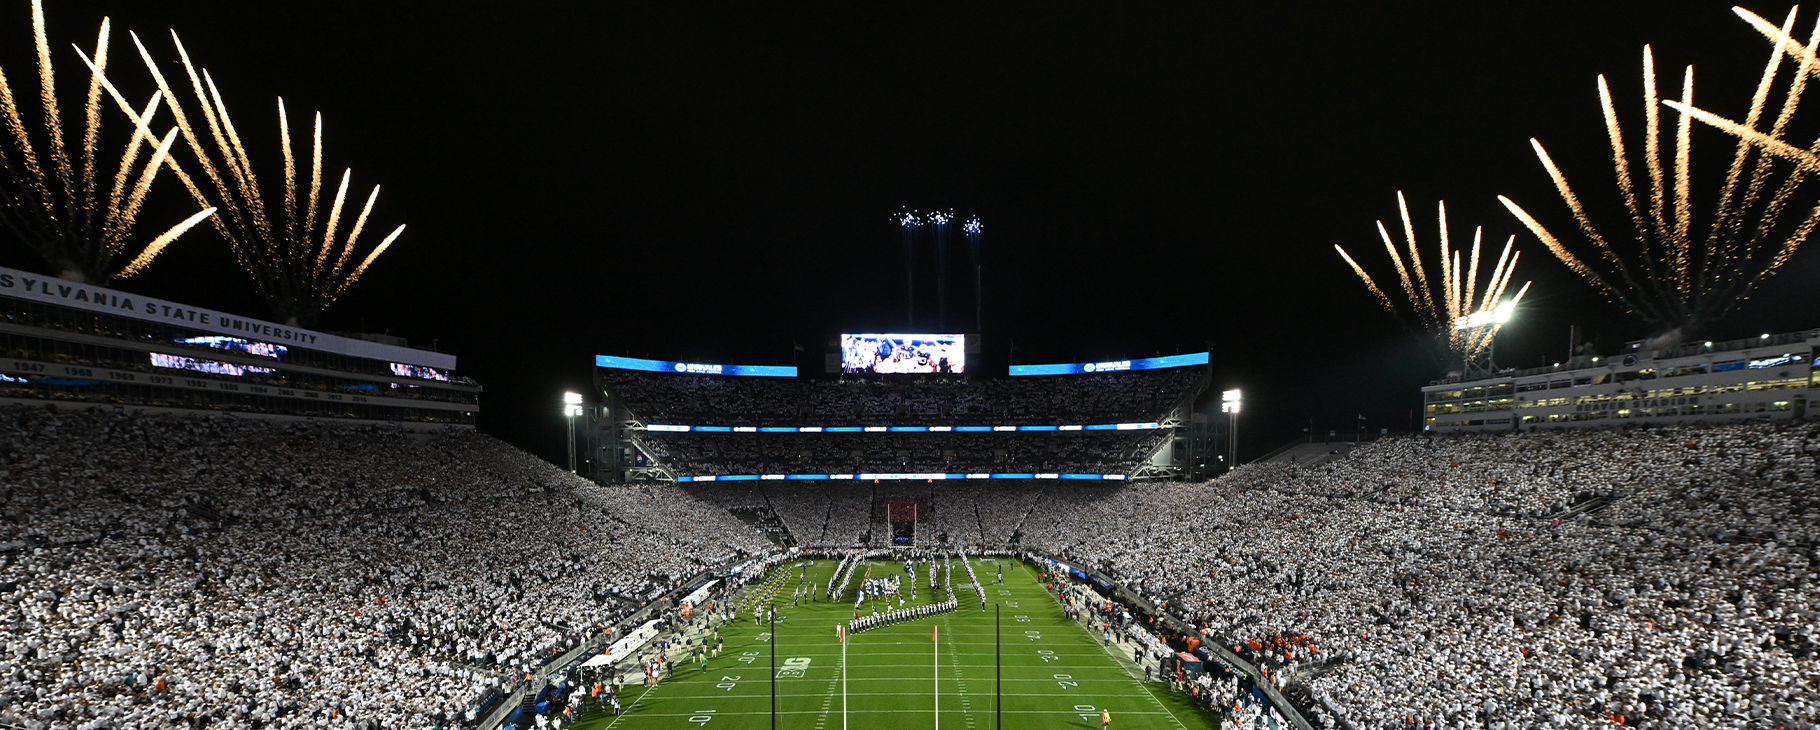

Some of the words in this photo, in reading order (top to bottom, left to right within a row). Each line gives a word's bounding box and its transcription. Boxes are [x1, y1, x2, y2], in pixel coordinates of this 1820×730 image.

[0, 274, 134, 310] SYLVANIA
[146, 303, 209, 324] STATE
[220, 317, 317, 344] UNIVERSITY
[13, 362, 45, 373] 1947
[65, 367, 93, 377] 1968
[108, 371, 135, 381] 1969
[151, 376, 173, 385] 1973
[186, 379, 207, 388] 1982
[219, 383, 239, 391] 1986
[250, 386, 267, 394] 1994
[327, 393, 342, 401] 2012
[1576, 401, 1626, 412] BEAVER
[1633, 397, 1699, 408] STADIUM
[716, 676, 741, 688] 20
[1053, 674, 1078, 687] 20
[689, 710, 716, 723] 10
[1074, 705, 1100, 717] 10
